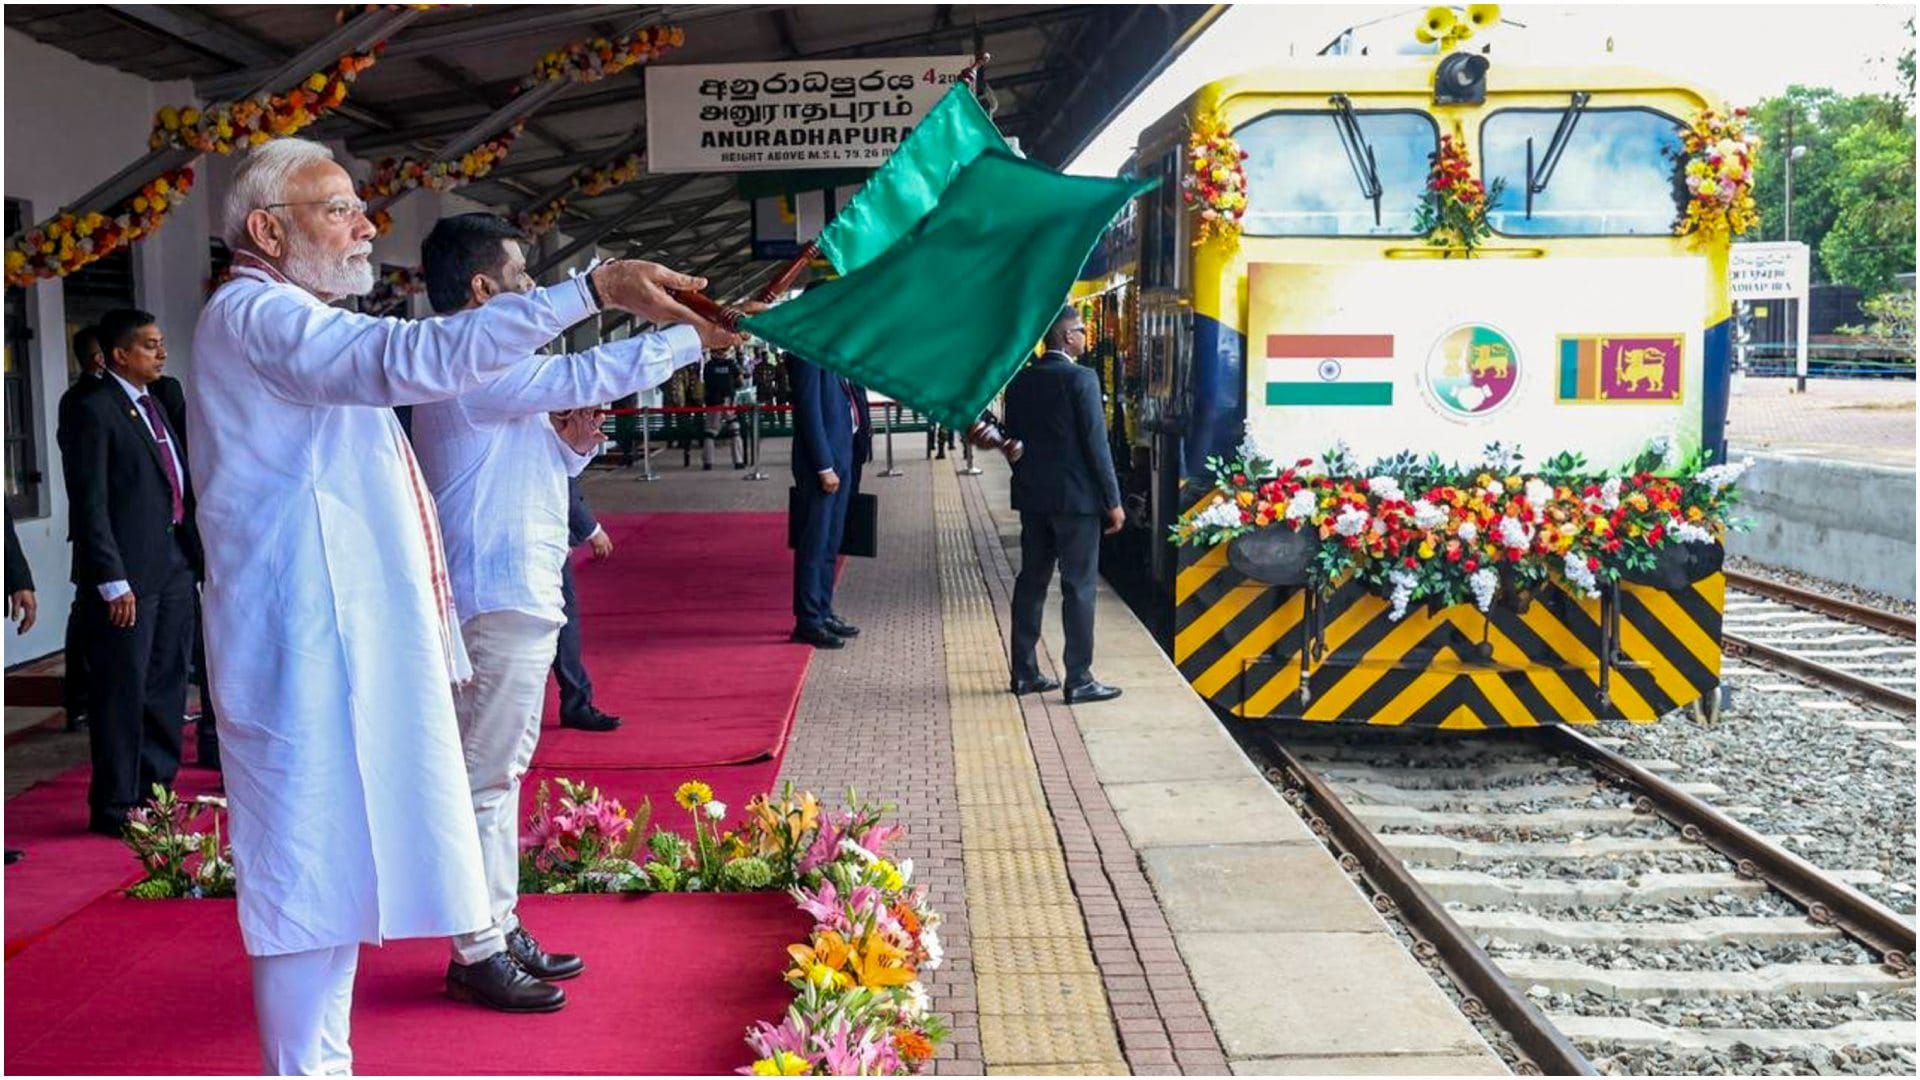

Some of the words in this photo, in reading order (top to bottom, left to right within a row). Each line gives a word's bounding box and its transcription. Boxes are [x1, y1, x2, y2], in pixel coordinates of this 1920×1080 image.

[698, 69, 914, 101] අනුරාධපුරය
[922, 67, 936, 85] 4
[699, 94, 913, 127] அனுராதபுரம்
[701, 126, 913, 148] ANURADHAPURA
[721, 152, 763, 162] HEIGHT
[767, 151, 804, 160] ABOVE
